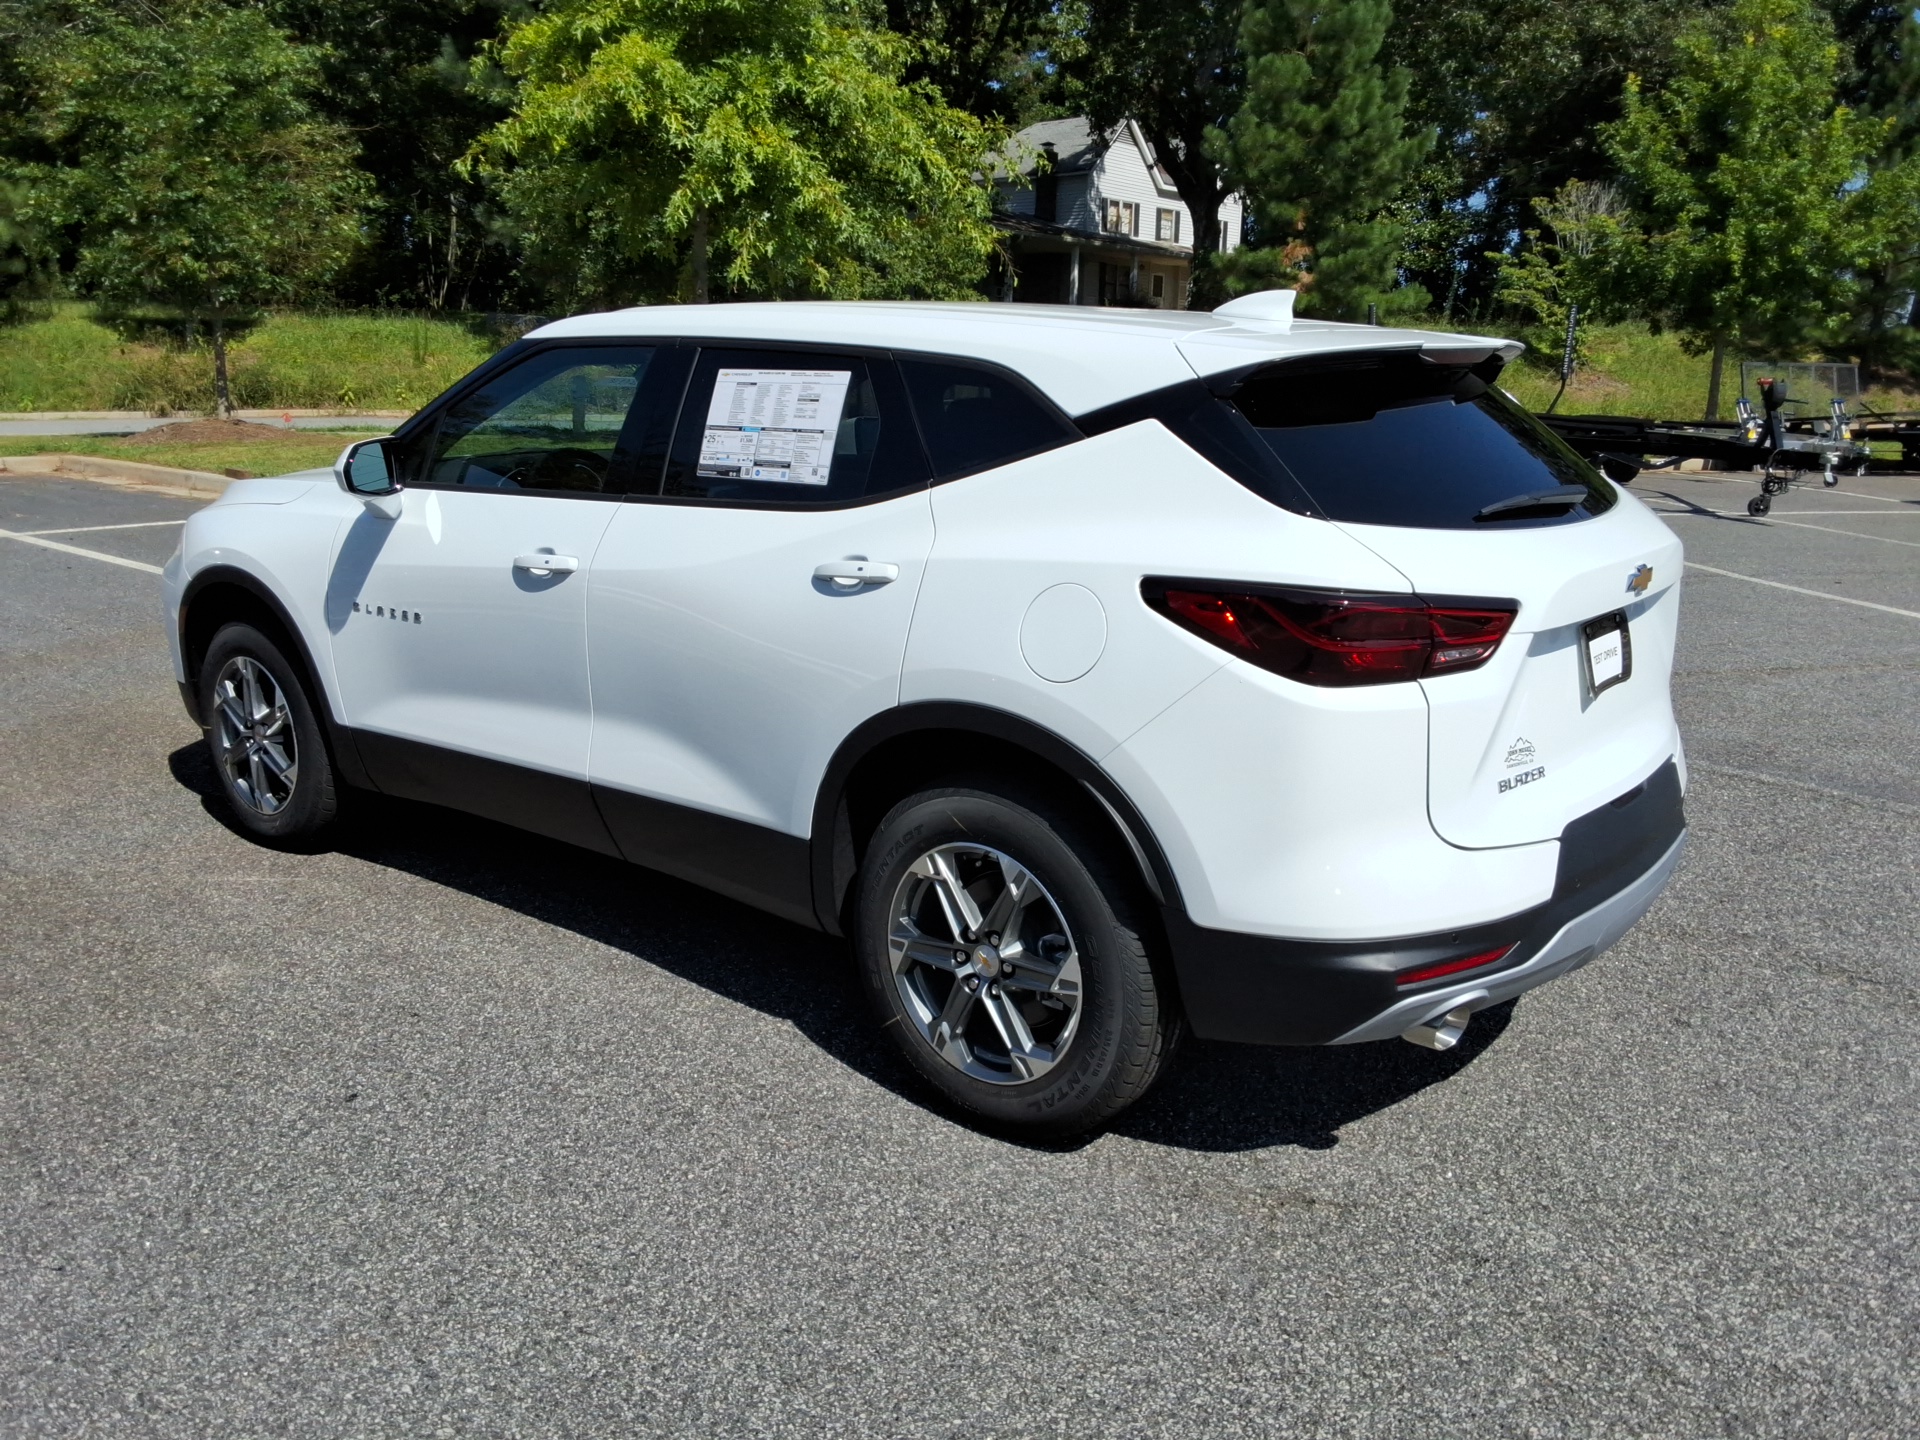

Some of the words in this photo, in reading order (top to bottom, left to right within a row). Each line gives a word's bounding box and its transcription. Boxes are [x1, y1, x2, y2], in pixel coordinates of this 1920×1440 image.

[1562, 348, 1570, 373] MARINE
[352, 601, 422, 625] BLAZER
[1593, 653, 1604, 665] TEST
[1603, 646, 1618, 661] DRIVE
[1498, 766, 1546, 793] BLAZER
